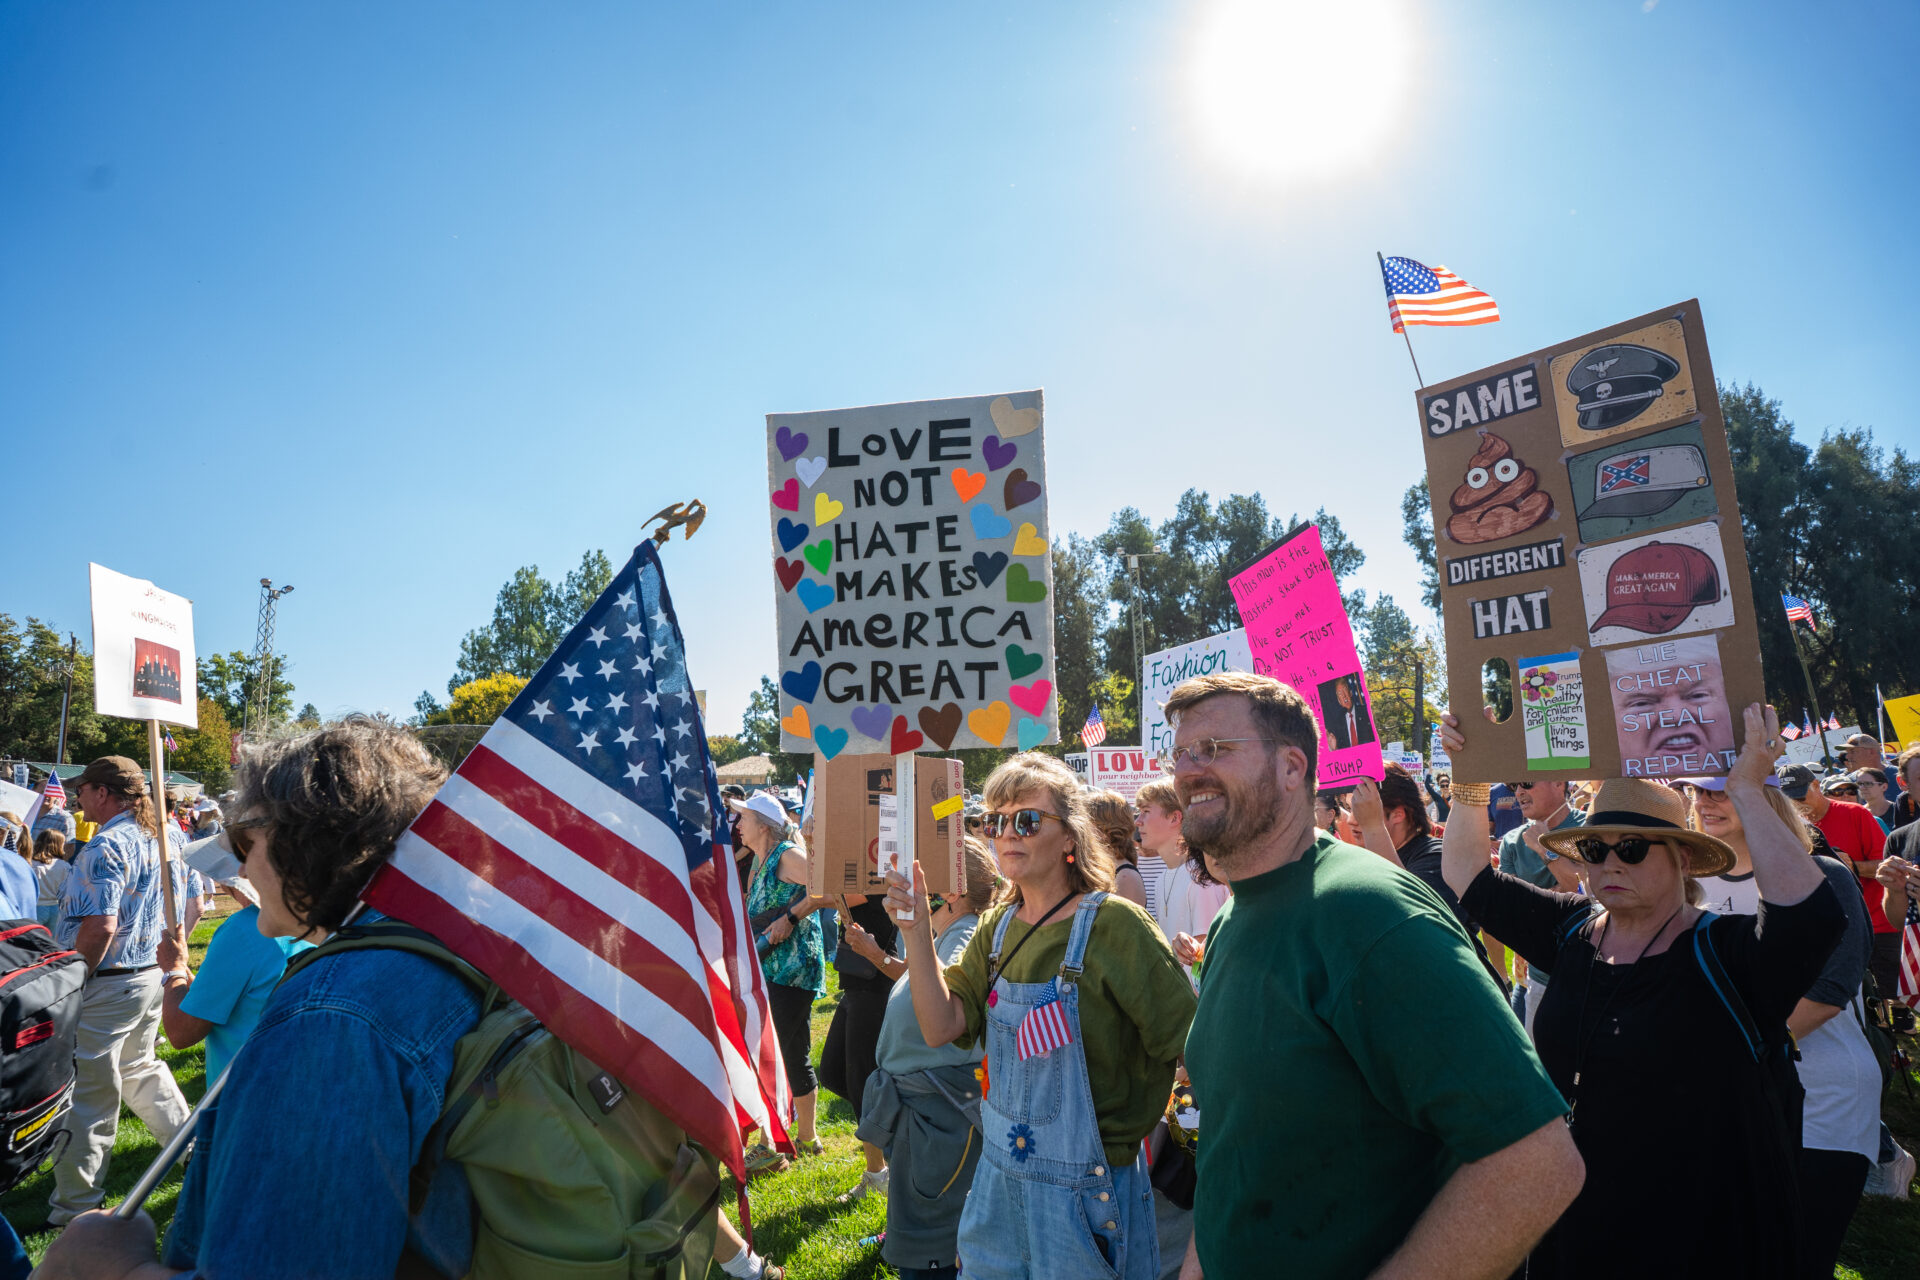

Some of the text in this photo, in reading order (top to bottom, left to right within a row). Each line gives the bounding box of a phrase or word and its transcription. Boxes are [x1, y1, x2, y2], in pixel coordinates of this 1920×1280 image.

[1429, 370, 1538, 434] SAME
[854, 467, 940, 508] NOT
[834, 515, 962, 562] HATE
[1257, 565, 1275, 582] man
[1275, 557, 1287, 571] is
[1289, 545, 1310, 561] the
[1449, 542, 1561, 584] DIFFERENT
[1613, 582, 1677, 595] GREAT AGAIN
[1615, 572, 1680, 583] MAKE AMERICA
[1242, 594, 1274, 625] nastiest
[1303, 558, 1330, 579] bitch
[1474, 591, 1547, 638] HAT
[1275, 620, 1293, 638] ever
[1254, 622, 1335, 676] Do NOT TRUST
[1637, 643, 1677, 664] LIE
[1151, 649, 1228, 688] Fashion
[1290, 673, 1304, 688] He
[1306, 666, 1317, 678] is
[1556, 672, 1582, 681] Trump
[1616, 663, 1706, 692] CHEAT
[823, 660, 998, 704] GREAT
[1566, 681, 1582, 690] not
[1543, 692, 1582, 706] healthy
[1526, 704, 1583, 718] for children
[1527, 716, 1544, 726] and
[1622, 707, 1715, 732] STEAL
[1151, 721, 1175, 751] Fa
[1550, 725, 1576, 738] living
[1551, 737, 1585, 751] things
[1097, 752, 1162, 772] LOVE
[1326, 759, 1363, 777] TRUMP
[1625, 750, 1737, 777] REPEAT
[1097, 773, 1119, 781] your
[955, 851, 963, 894] target.com
